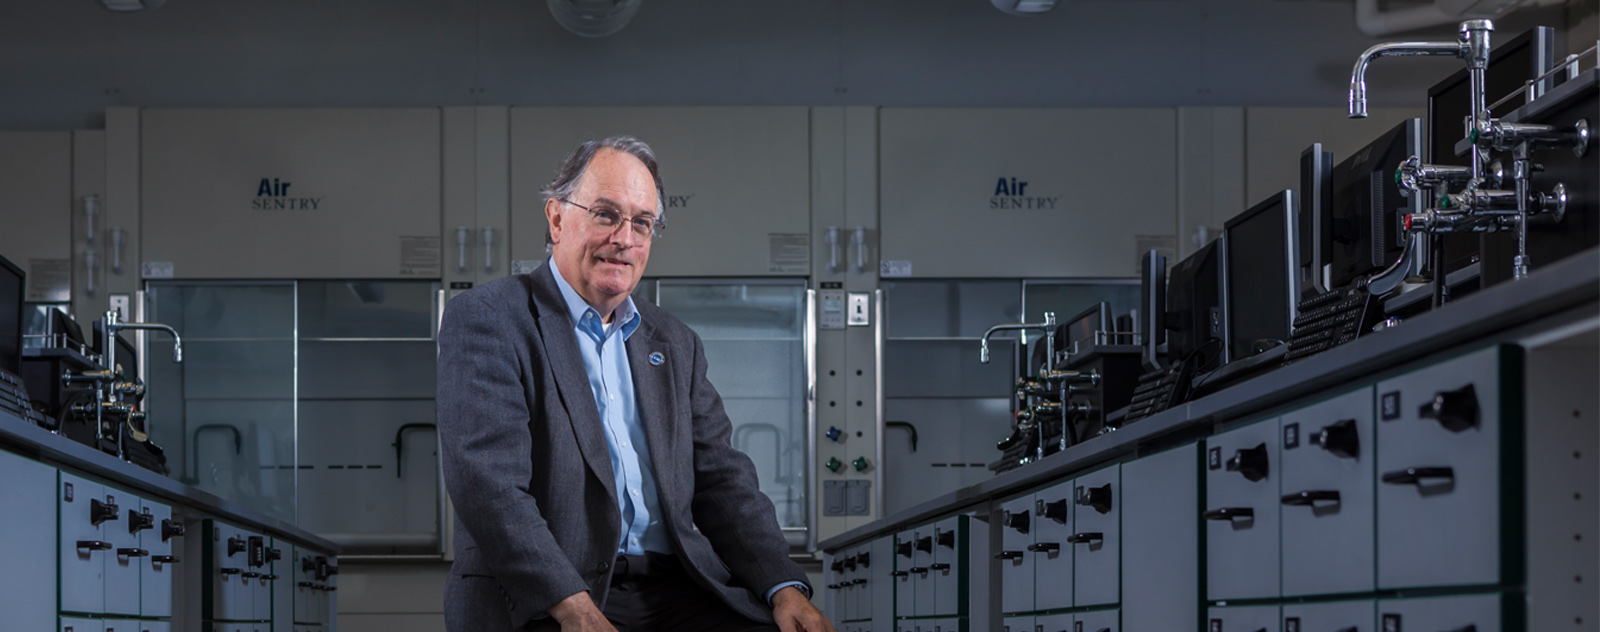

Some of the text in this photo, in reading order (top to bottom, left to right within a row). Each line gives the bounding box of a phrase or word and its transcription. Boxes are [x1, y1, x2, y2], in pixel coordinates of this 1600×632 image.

[257, 178, 291, 196] Air
[995, 177, 1028, 196] Air
[252, 197, 321, 210] SENTRY
[989, 197, 1058, 209] SENTRY
